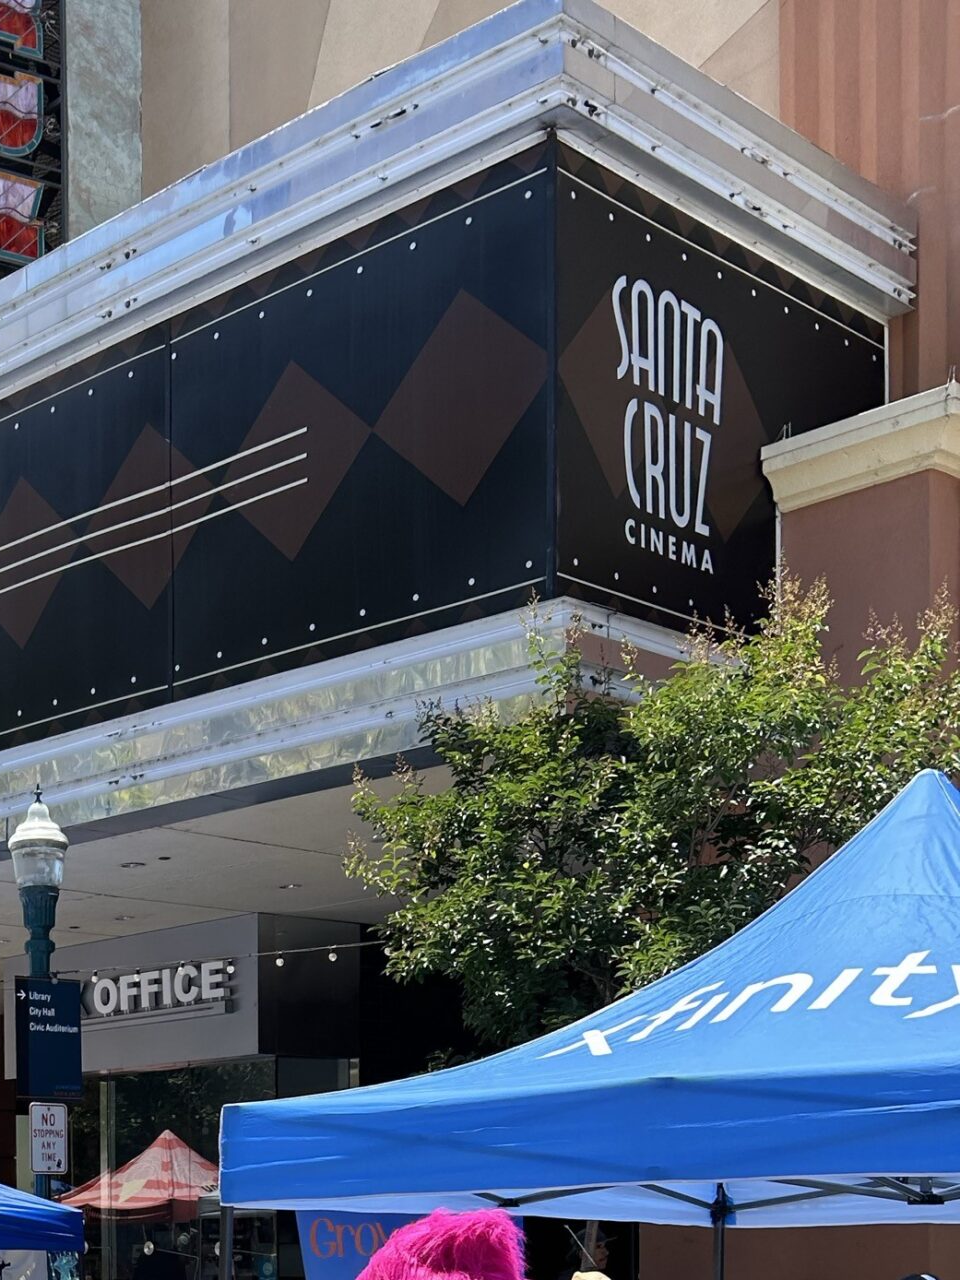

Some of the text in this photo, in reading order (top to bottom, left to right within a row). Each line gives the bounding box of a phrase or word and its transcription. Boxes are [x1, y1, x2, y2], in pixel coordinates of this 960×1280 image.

[611, 275, 724, 426] SANTA
[624, 398, 712, 537] CRUZ
[625, 518, 714, 575] CINEMA
[93, 961, 224, 1016] OFFICE
[29, 991, 51, 1002] Library
[29, 1006, 55, 1017] City Hall
[29, 1022, 78, 1033] Civic Auditorium
[42, 1113, 55, 1126] NO
[33, 1129, 63, 1138] STOPPING
[42, 1141, 56, 1150] ANY
[42, 1153, 56, 1162] TIME
